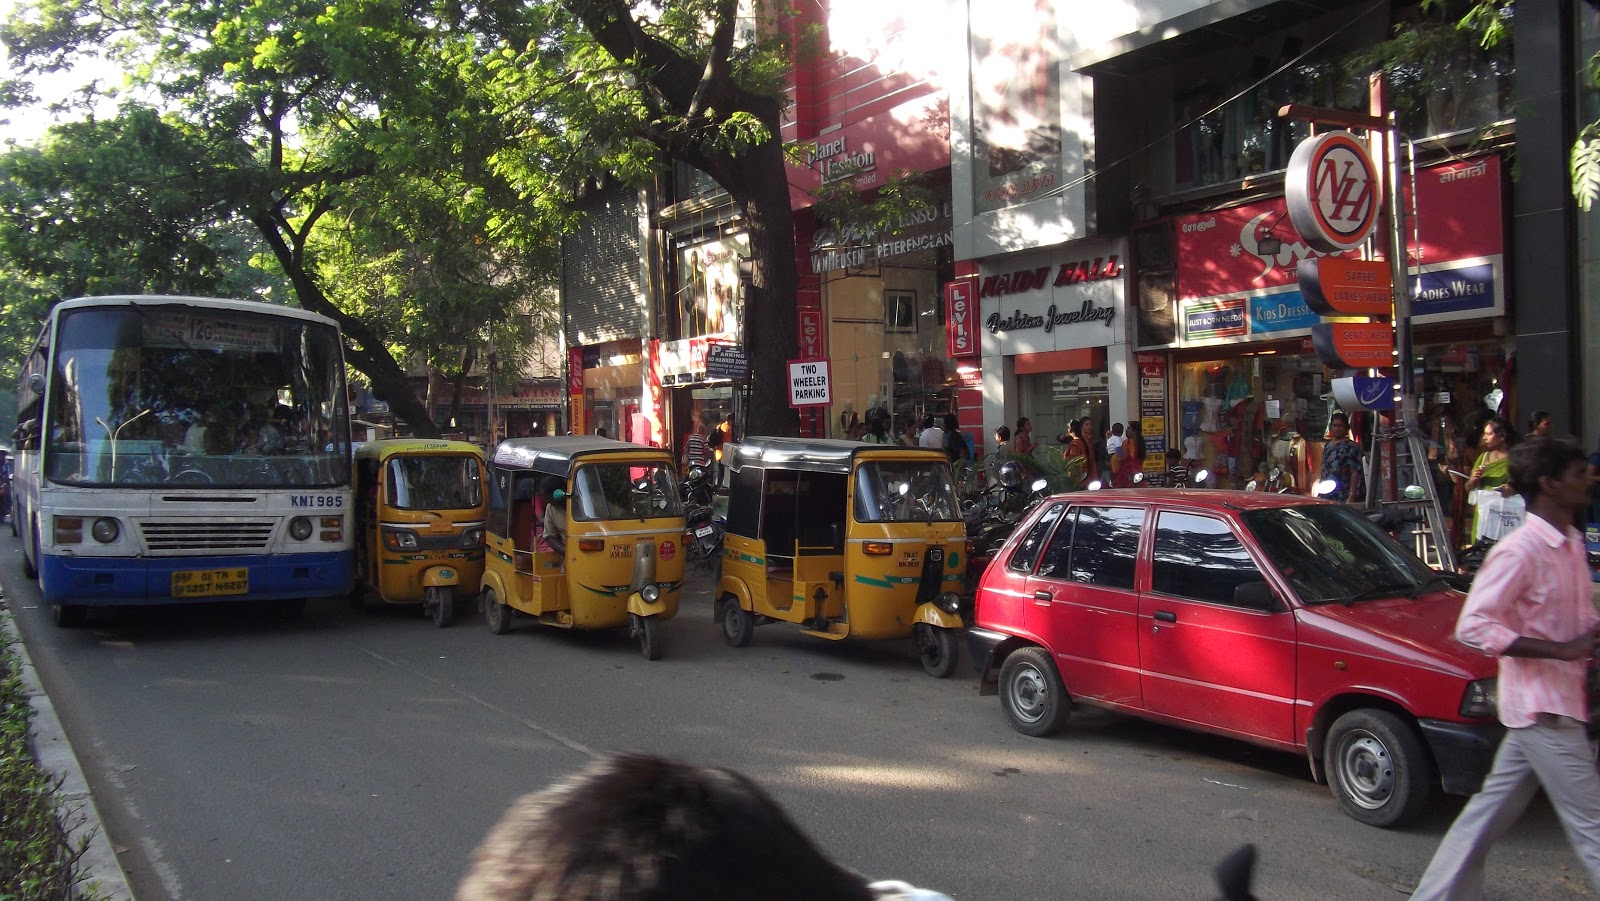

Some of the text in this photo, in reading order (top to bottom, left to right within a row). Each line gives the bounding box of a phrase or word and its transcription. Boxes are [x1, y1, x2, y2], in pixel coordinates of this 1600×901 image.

[1310, 158, 1378, 222] NH
[979, 255, 1122, 299] NAIDU HALL
[1346, 271, 1377, 282] SAREES
[1452, 280, 1486, 297] WEAR
[1333, 291, 1362, 302] LADIES
[985, 299, 1116, 333] Fashion Jewellery
[1256, 303, 1315, 321] KIDS DRESSE
[1189, 313, 1242, 327] JUST BORN NEEDS
[1343, 330, 1368, 340] GENTS
[711, 345, 745, 359] PARKING
[801, 364, 818, 375] TWO
[793, 376, 827, 388] WHEELER
[795, 388, 827, 400] PARKING
